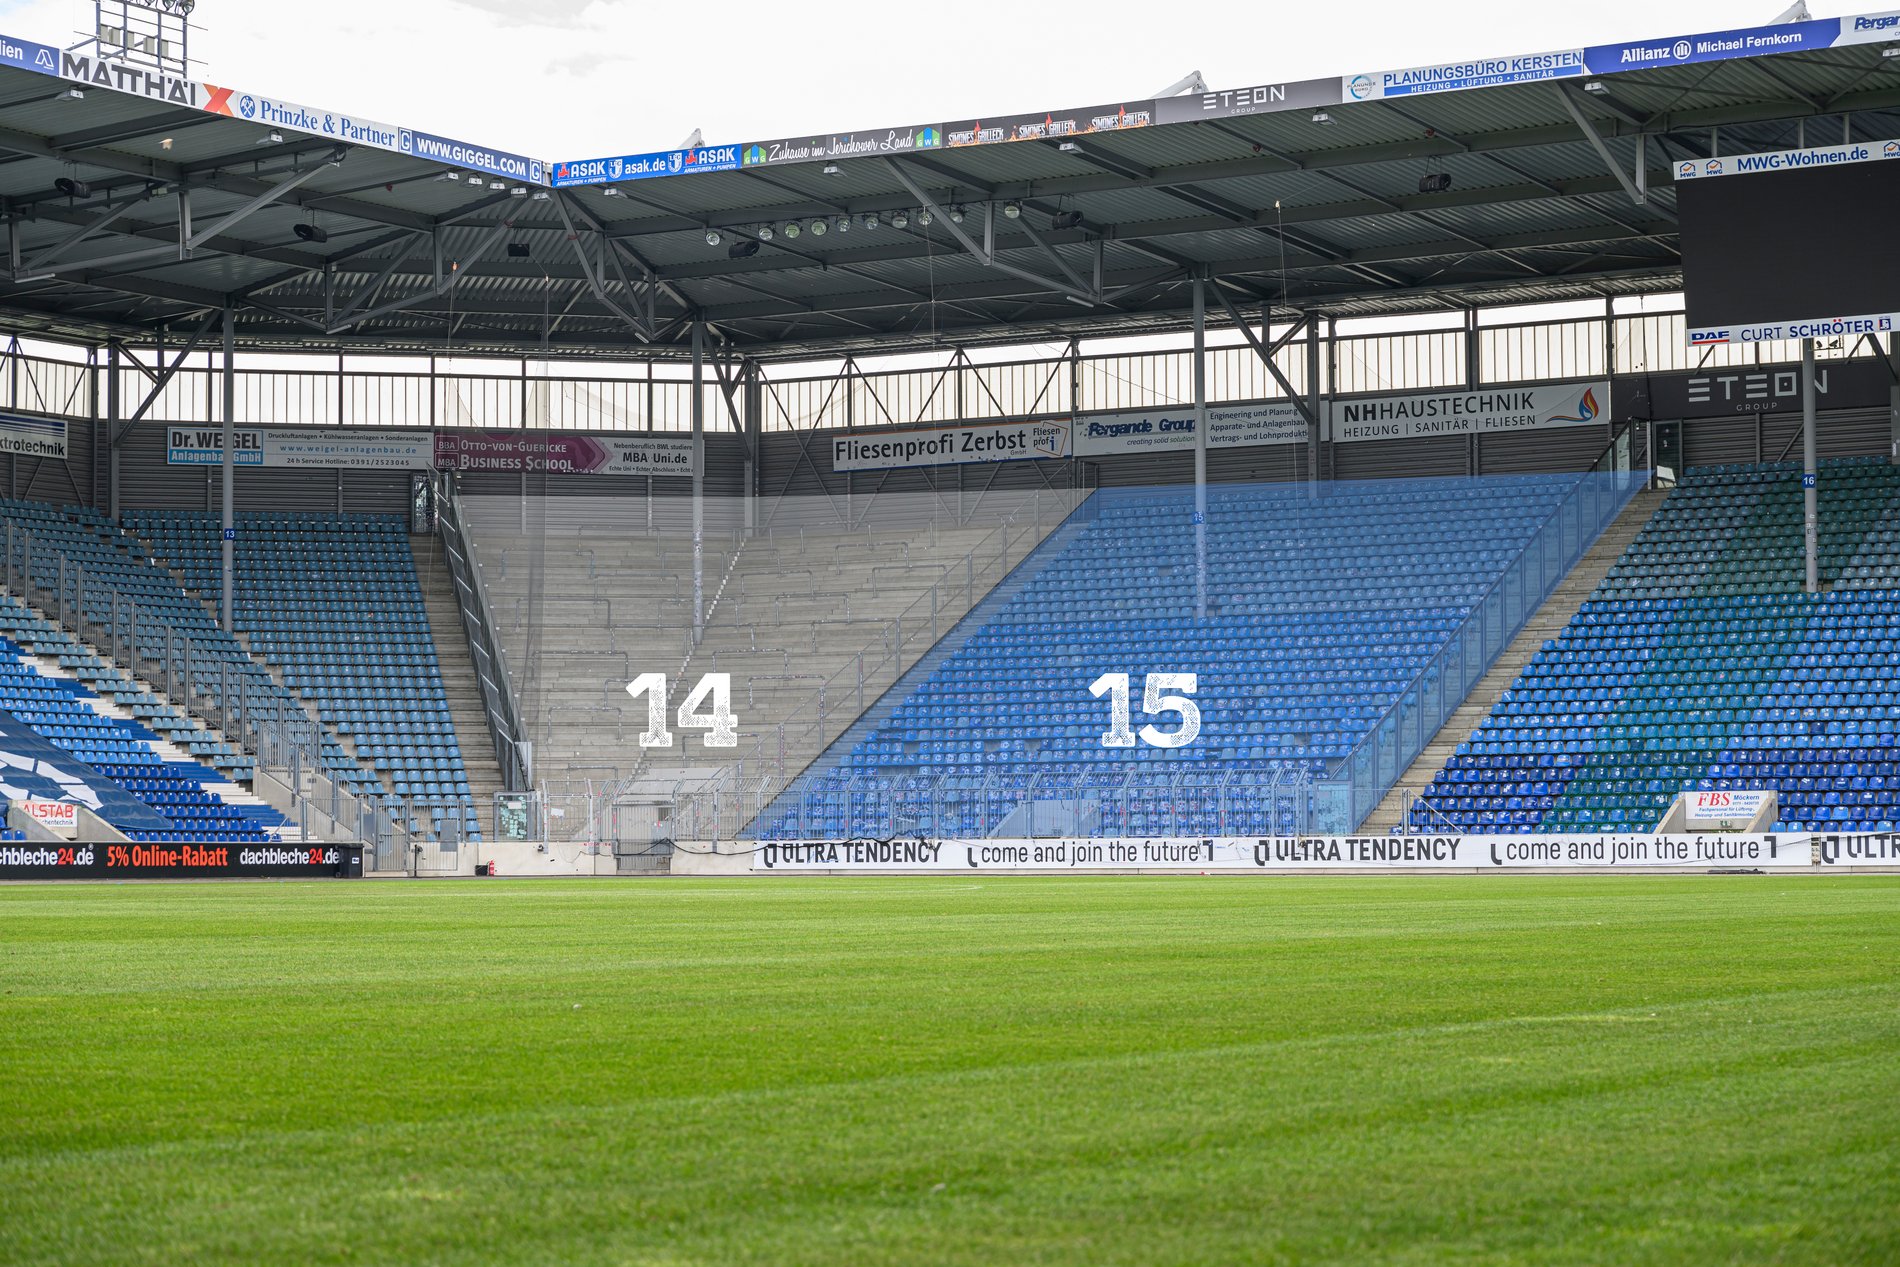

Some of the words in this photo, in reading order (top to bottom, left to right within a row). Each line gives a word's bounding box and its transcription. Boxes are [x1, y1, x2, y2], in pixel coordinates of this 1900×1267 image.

[1696, 37, 1744, 53] Michael
[1746, 31, 1802, 48] Fernkorn
[1620, 44, 1670, 63] Allianz
[1383, 60, 1507, 86] PLANUNGSBÜRO
[1512, 52, 1582, 71] KERSTEN
[62, 52, 196, 106] MATTHÄI
[1411, 82, 1450, 93] HEIZUNG
[1461, 76, 1503, 87] LÜFTUNG
[1513, 70, 1554, 81] SANITÄR
[1203, 85, 1285, 110] ETEON
[260, 100, 318, 130] Prinzke
[322, 114, 336, 134] &
[340, 117, 396, 147] Partner
[1019, 124, 1045, 138] SIMONES
[1092, 116, 1118, 129] SIMONES
[768, 142, 809, 162] Zuhause
[811, 146, 825, 157] im
[880, 129, 914, 150] Land
[949, 132, 974, 145] SIMONES
[416, 137, 526, 176] WWW.GIGGEL.COM
[698, 147, 736, 164] ASAK
[1737, 146, 1869, 172] MWG-Wohnen.de
[571, 161, 606, 178] ASAK
[625, 158, 666, 174] asak.de
[1692, 330, 1730, 341] DAF
[1741, 327, 1782, 342] CURT
[1789, 318, 1874, 337] SCHRÖTER
[1210, 410, 1252, 420] Engineering
[1253, 409, 1267, 417] und
[1269, 408, 1298, 417] Planung
[1736, 402, 1778, 411] GROUP
[1033, 427, 1061, 436] Fliesen
[1088, 419, 1153, 437] Pergande
[1210, 423, 1245, 432] Apparate-
[1247, 421, 1261, 429] und
[1262, 419, 1305, 428] Anlagenbau
[1344, 424, 1399, 438] HEIZUNG
[1415, 418, 1469, 433] SANITÄR
[1485, 414, 1536, 428] FLIESEN
[172, 432, 194, 448] Dr.
[196, 432, 261, 449] WEGEL
[268, 432, 318, 440] Druckluftanlagen
[385, 435, 428, 443] Sonderanlagen
[1210, 433, 1242, 443] Vertrags-
[1244, 432, 1257, 440] und
[1260, 430, 1308, 440] Lohnprodukti
[439, 441, 455, 450] BBA
[835, 433, 954, 461] Fliesenprofi
[961, 430, 1026, 453] Zerbst
[171, 451, 223, 462] Anlagenba
[233, 452, 261, 462] GmbH
[437, 458, 456, 467] MBA
[622, 452, 648, 462] MBA
[653, 453, 687, 463] Uni.de
[1803, 476, 1815, 485] 16
[225, 530, 235, 538] 13
[1697, 791, 1731, 806] FBS
[107, 845, 129, 867] 5%
[132, 845, 228, 867] Online-Rabatt
[240, 848, 340, 866] dachbleche24.de
[783, 842, 838, 863] ULTRA
[845, 842, 943, 863] TENDENCY
[981, 846, 1029, 864] come
[1034, 842, 1067, 864] and
[1070, 841, 1103, 867] join
[1108, 840, 1137, 862] the
[1143, 840, 1200, 862] future
[1276, 839, 1341, 861] ULTRA
[1345, 838, 1462, 861] TENDENCY
[1506, 840, 1561, 860] come
[1568, 837, 1604, 860] and
[1610, 837, 1648, 864] join
[1654, 837, 1689, 859] the
[1695, 836, 1760, 860] future
